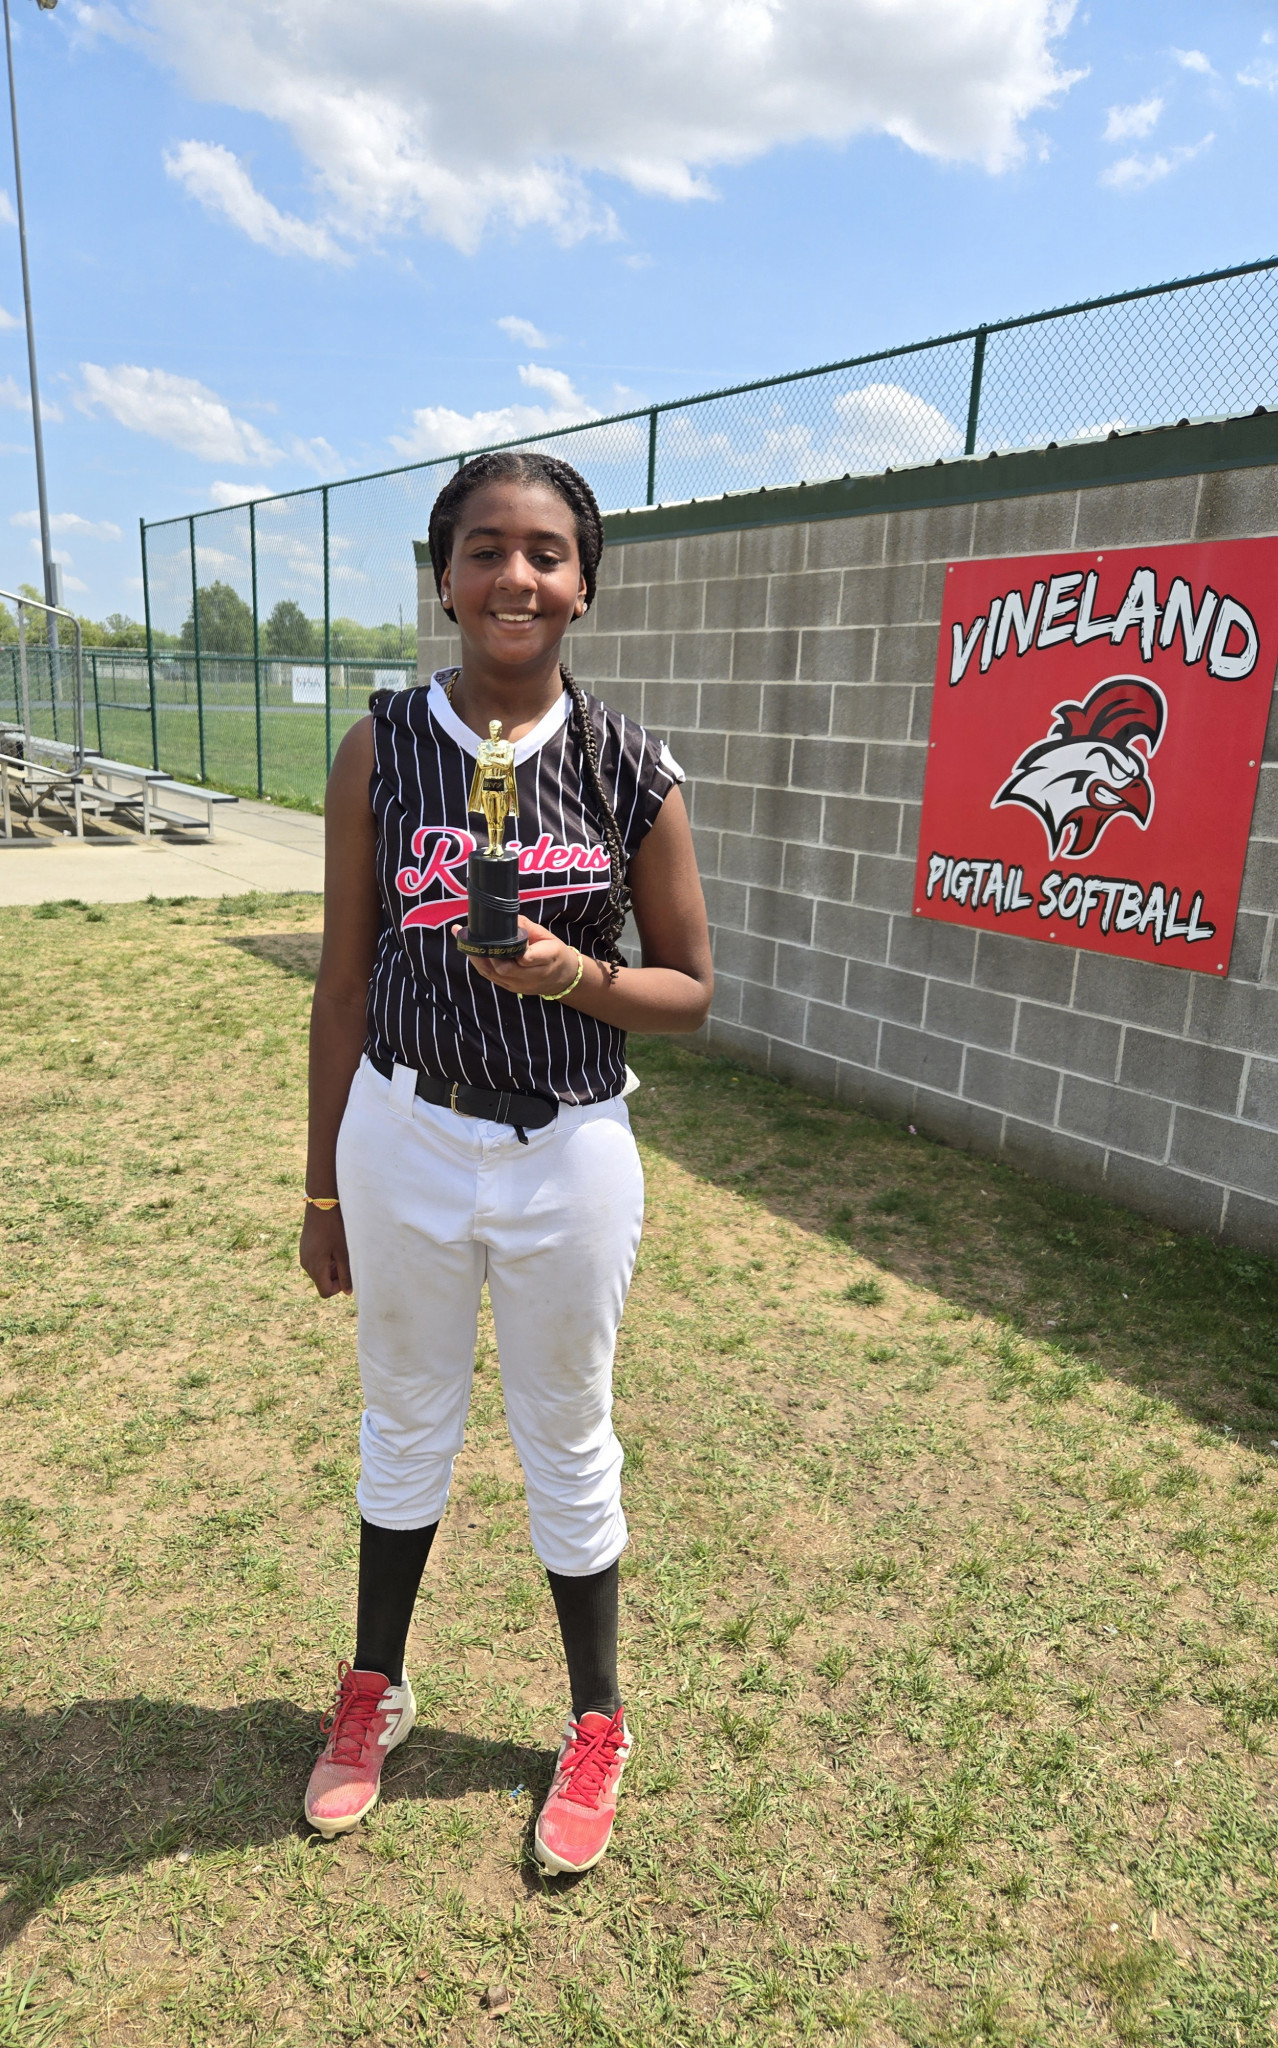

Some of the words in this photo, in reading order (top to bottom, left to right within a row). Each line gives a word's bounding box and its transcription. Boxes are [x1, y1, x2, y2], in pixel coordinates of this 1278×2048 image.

[949, 567, 1259, 685] VINELAND
[395, 826, 612, 897] Rders
[926, 852, 1034, 915] PIGTAIL
[1038, 870, 1215, 944] SOFTBALL
